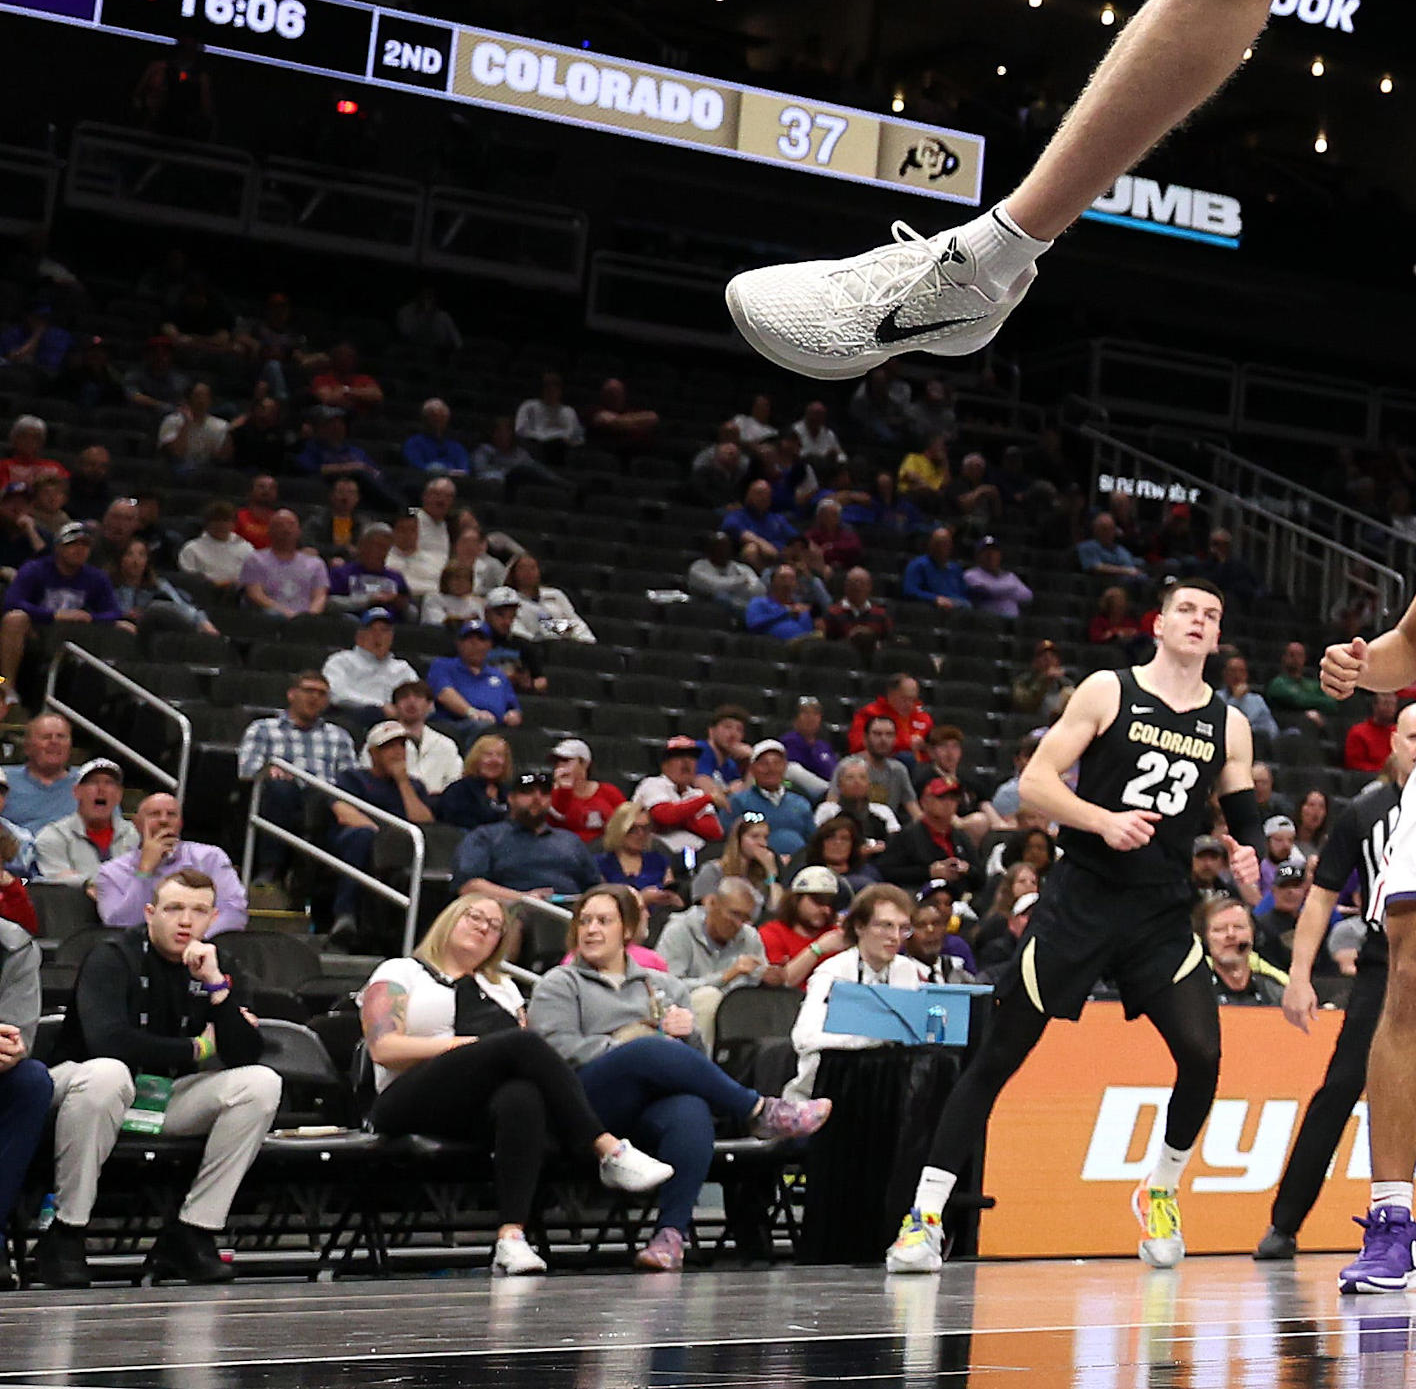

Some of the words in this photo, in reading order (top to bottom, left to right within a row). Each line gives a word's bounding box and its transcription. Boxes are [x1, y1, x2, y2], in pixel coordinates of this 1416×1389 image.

[383, 39, 443, 75] 2ND
[470, 42, 724, 131] COLORADO
[777, 106, 848, 165] 37
[1128, 721, 1216, 763] COLORADO
[1121, 751, 1200, 817] 23
